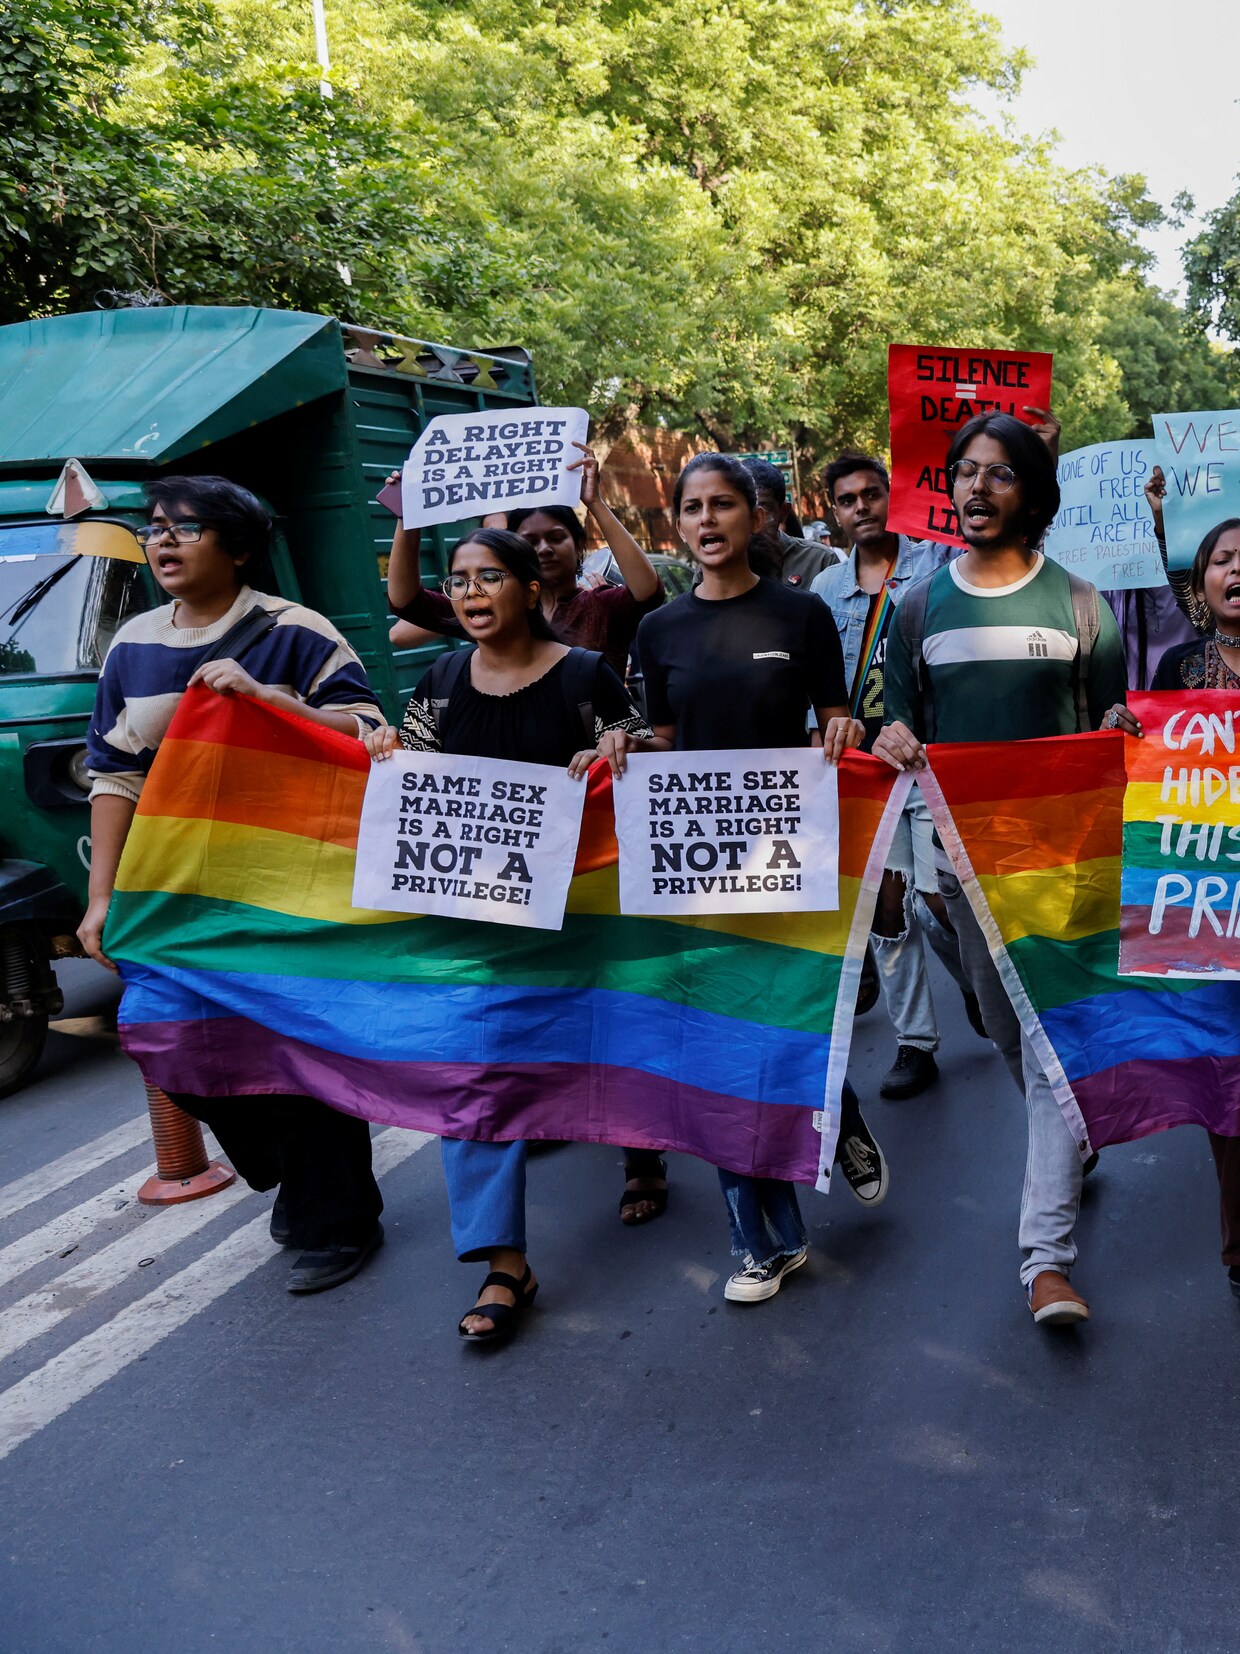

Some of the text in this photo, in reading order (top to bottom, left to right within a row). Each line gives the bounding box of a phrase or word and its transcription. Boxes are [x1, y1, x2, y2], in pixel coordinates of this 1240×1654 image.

[917, 355, 1030, 388] SILENCE
[425, 421, 566, 446] A RIGHT
[1165, 421, 1239, 454] WE
[424, 440, 564, 466] DELAYED
[1091, 452, 1112, 475] OF
[1121, 450, 1147, 475] US
[422, 458, 562, 483] IS A RIGHT
[1171, 462, 1224, 496] WE
[423, 474, 560, 509] DENIED!
[1100, 476, 1144, 499] FREE
[1111, 502, 1147, 521] ALL
[1090, 522, 1126, 543] ARE
[1058, 541, 1158, 565] FREE PALESTINE
[1112, 561, 1144, 580] FREE
[402, 772, 547, 805] SAME SEX
[649, 770, 799, 793] SAME SEX
[400, 795, 543, 827] MARRIAGE
[649, 794, 800, 815] MARRIAGE
[398, 818, 540, 849] IS A RIGHT
[650, 817, 801, 838] IS A RIGHT
[394, 840, 533, 883] NOT A
[651, 840, 801, 872] NOT A
[391, 873, 532, 905] PRIVILEGE!
[652, 874, 802, 895] PRIVILEGE!
